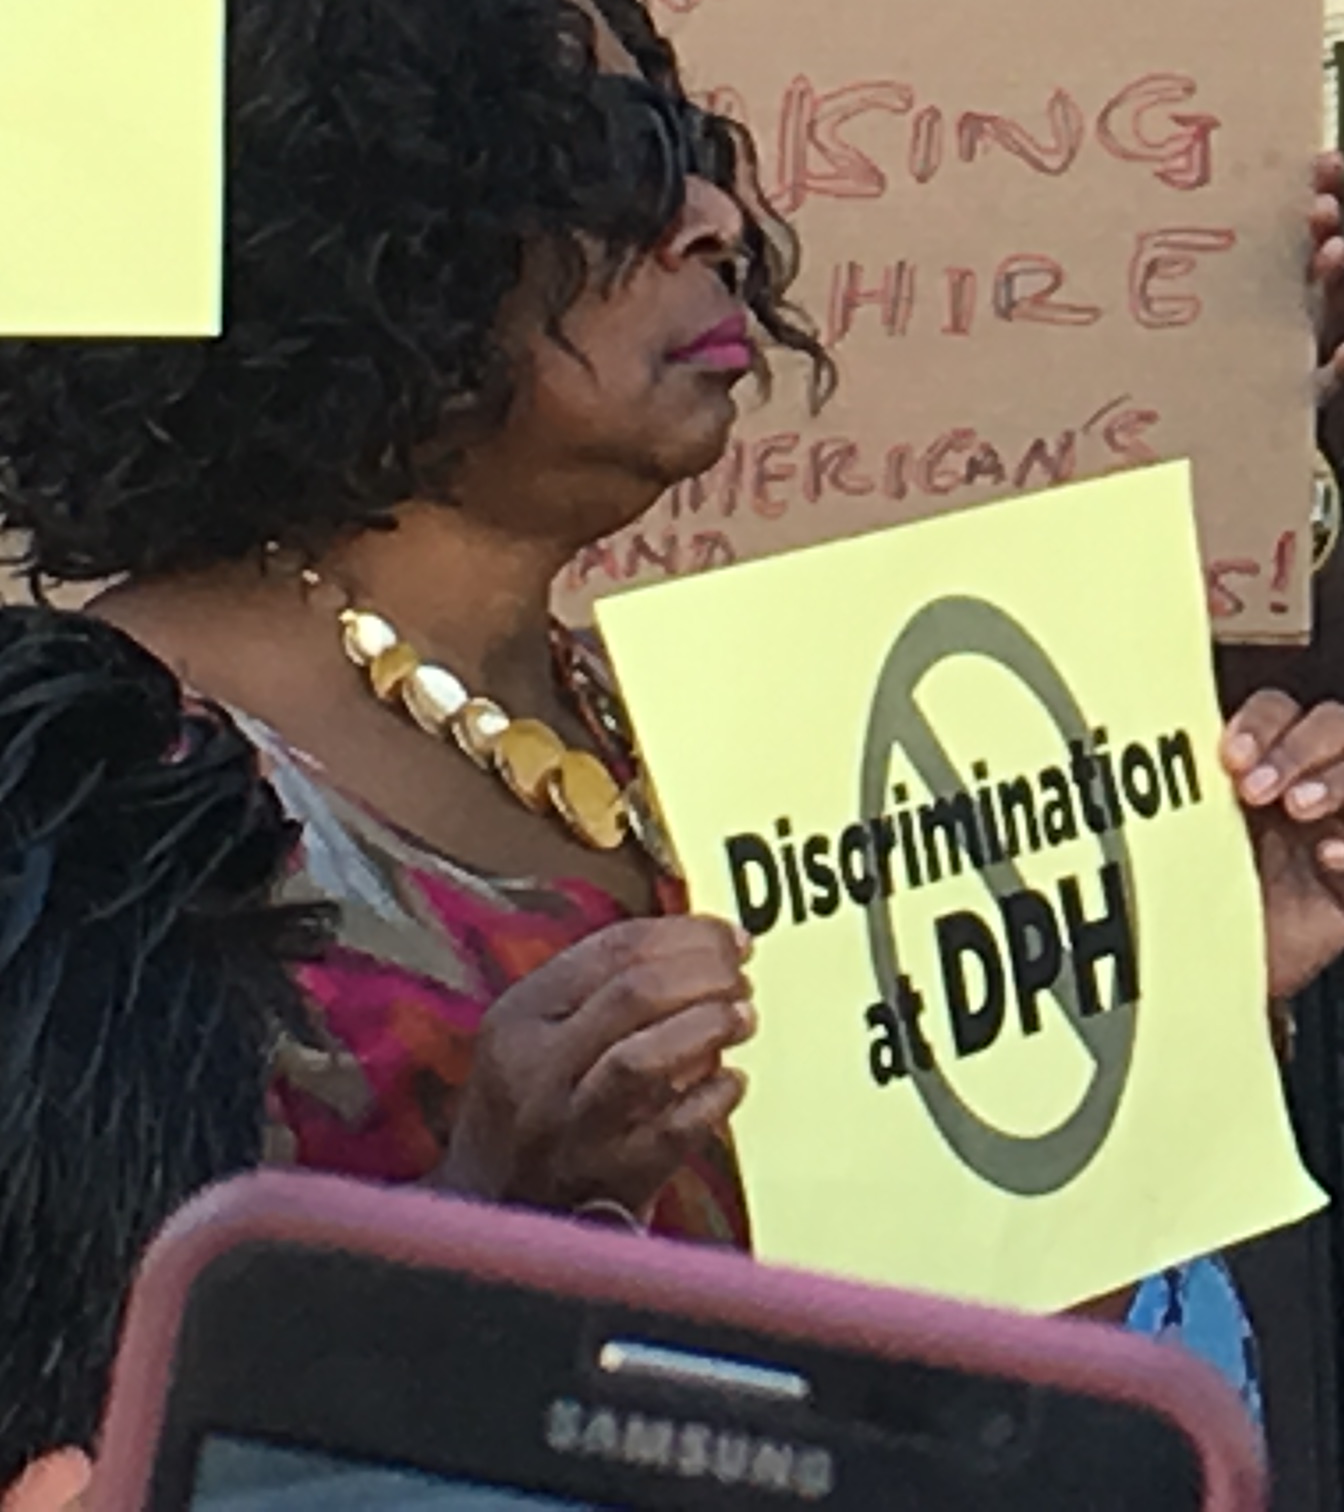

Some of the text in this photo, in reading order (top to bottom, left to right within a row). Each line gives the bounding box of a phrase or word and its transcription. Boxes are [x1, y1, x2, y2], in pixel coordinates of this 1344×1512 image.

[826, 227, 1237, 348] HIRE
[667, 392, 1161, 521] MERICAN'S
[1208, 529, 1297, 618] S!
[723, 725, 1203, 938] Discrimination
[863, 861, 1141, 1087] at DPH
[546, 1395, 834, 1499] SAMSUNG
